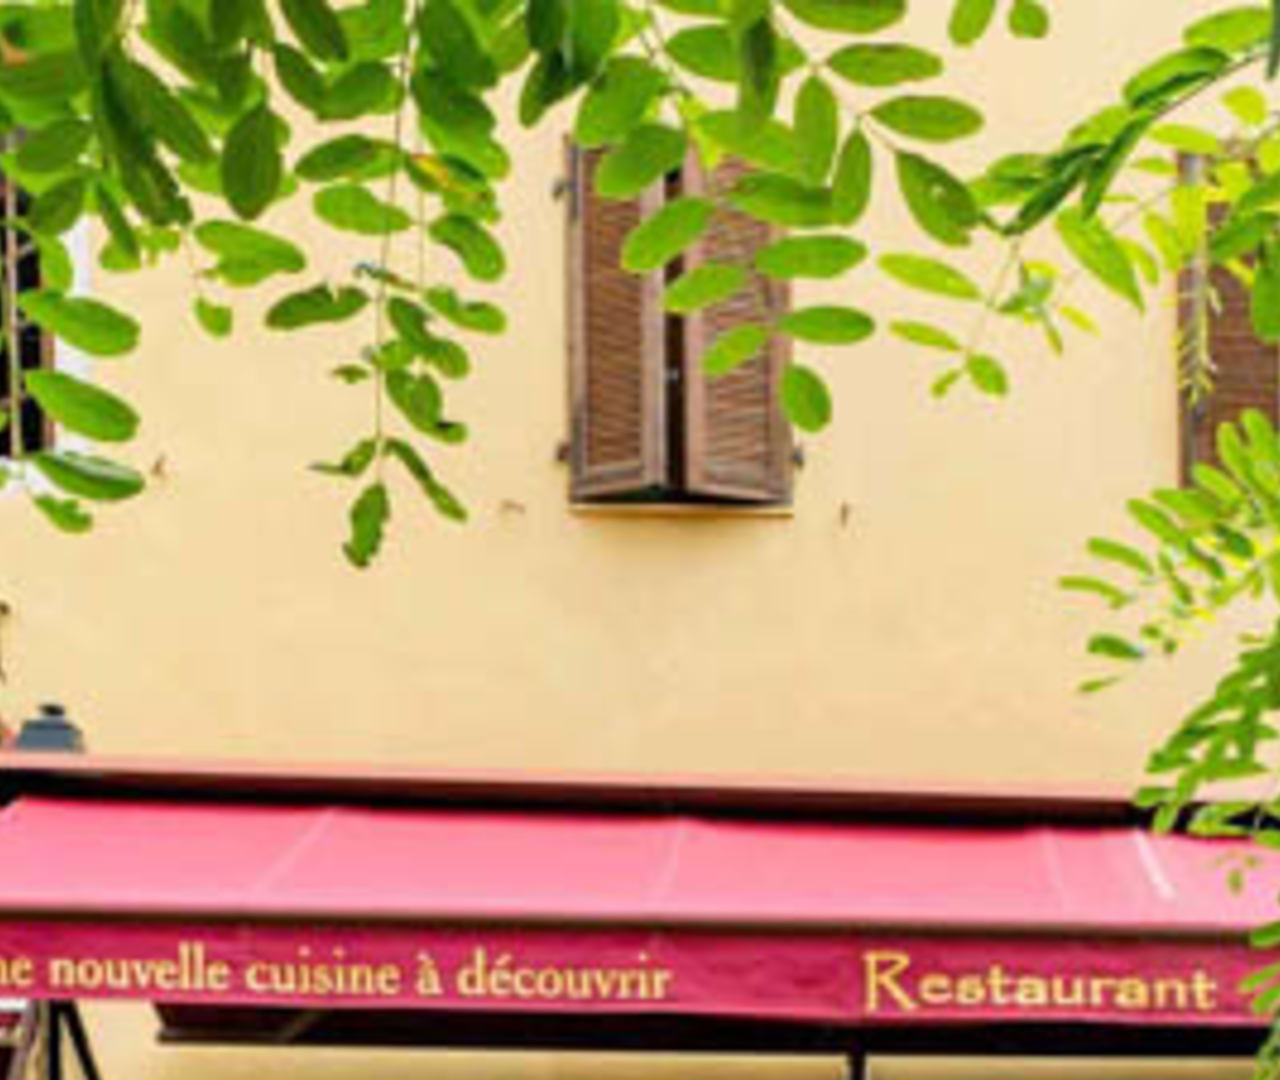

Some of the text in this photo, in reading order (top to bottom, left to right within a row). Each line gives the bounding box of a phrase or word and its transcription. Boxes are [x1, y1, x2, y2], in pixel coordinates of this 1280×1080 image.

[48, 938, 231, 991] nouvelle
[244, 944, 401, 996] cuisine
[414, 949, 444, 997] à
[455, 944, 673, 1001] découvrir
[862, 951, 1218, 1015] Restaurant
